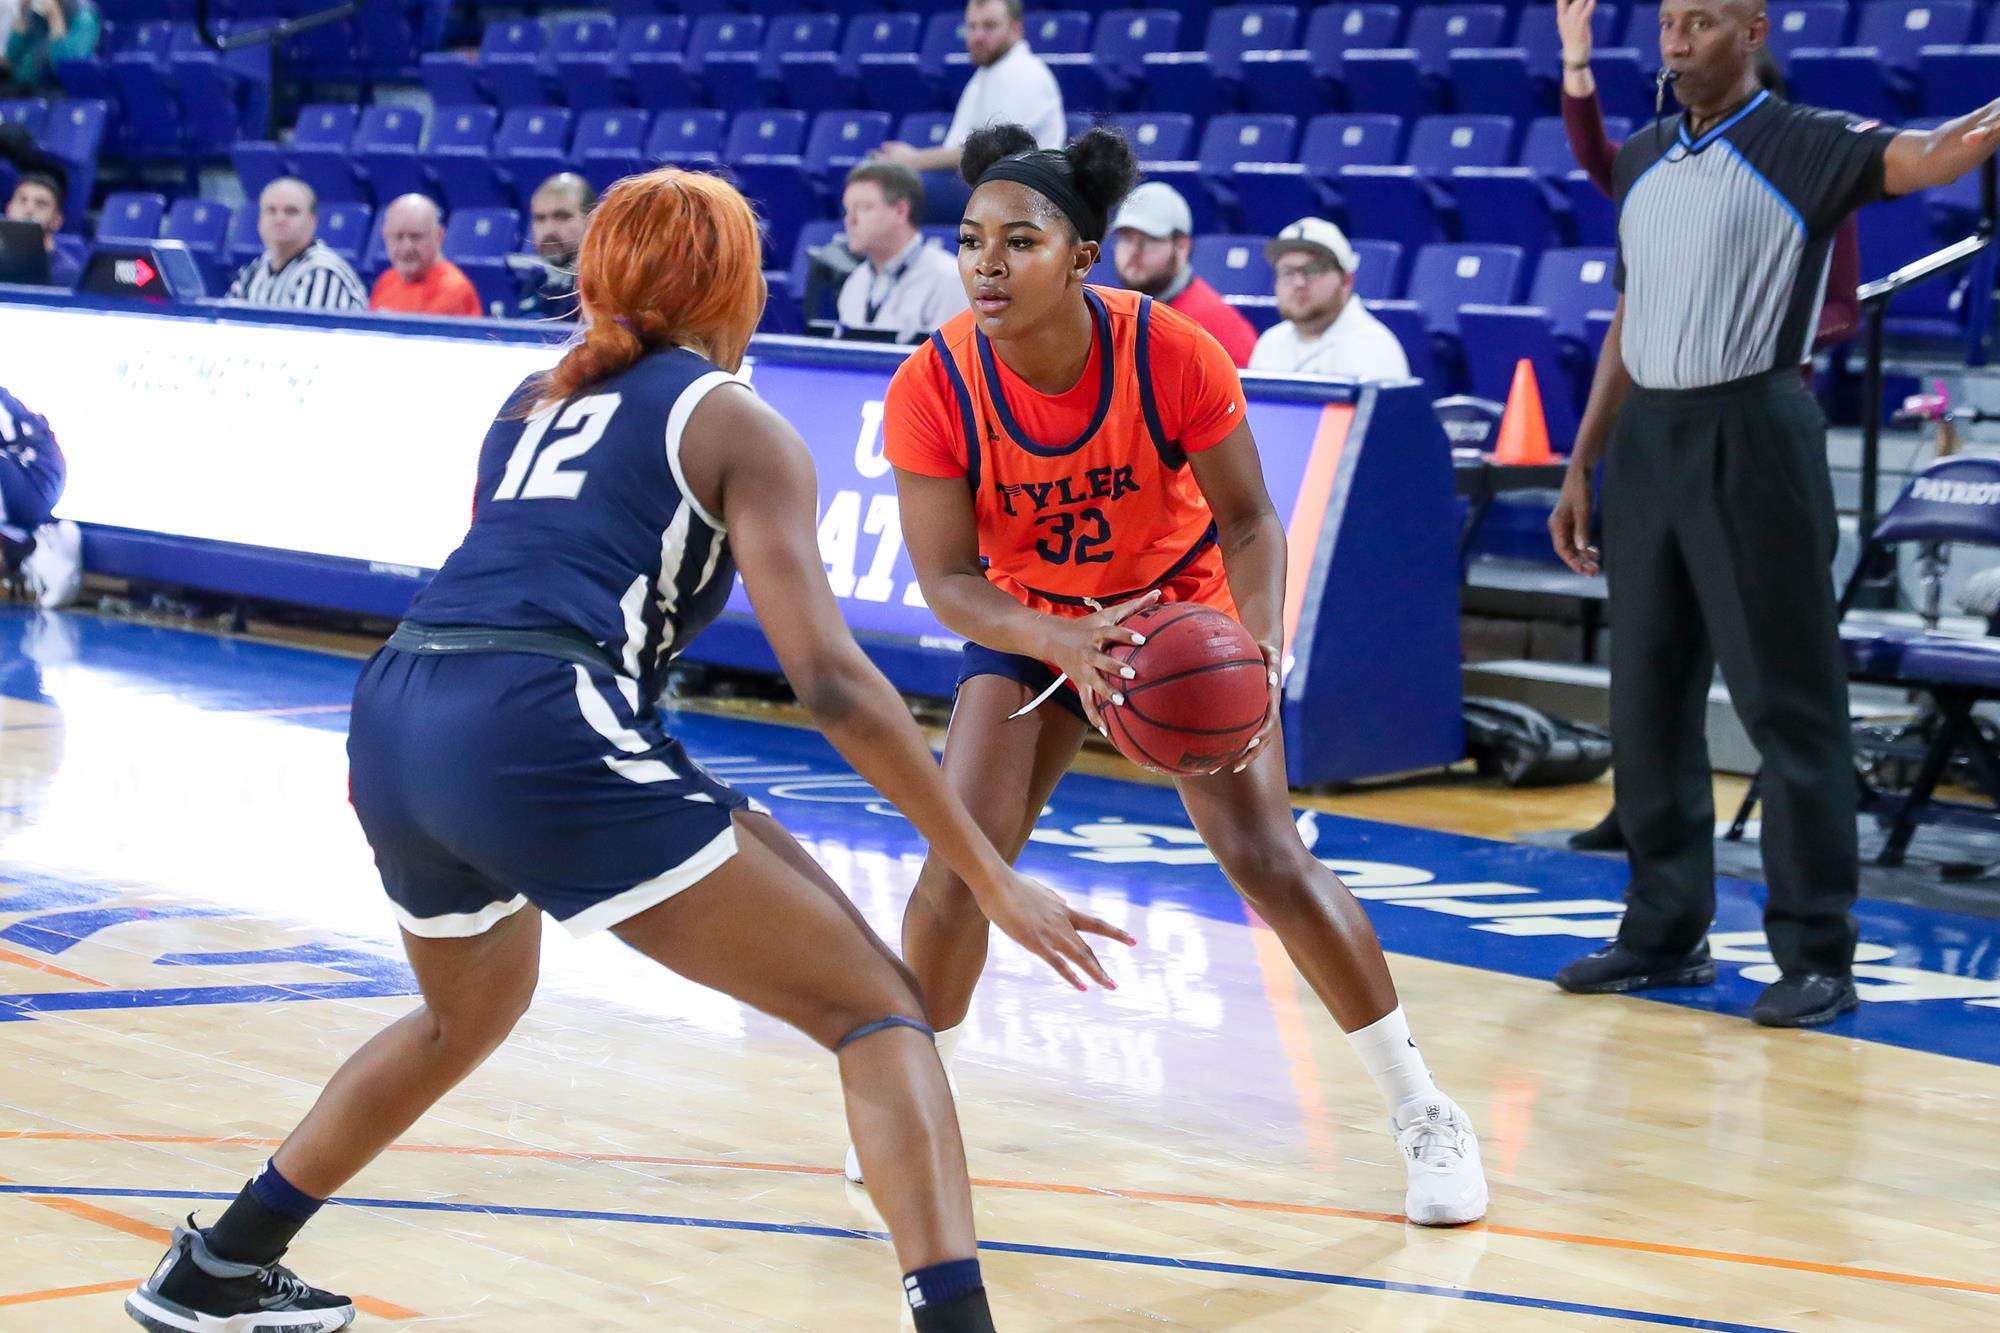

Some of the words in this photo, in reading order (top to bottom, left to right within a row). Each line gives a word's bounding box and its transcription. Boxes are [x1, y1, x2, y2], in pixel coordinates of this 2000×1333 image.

[491, 392, 622, 502] 12
[996, 464, 1141, 517] TYLER
[1034, 508, 1114, 565] 32
